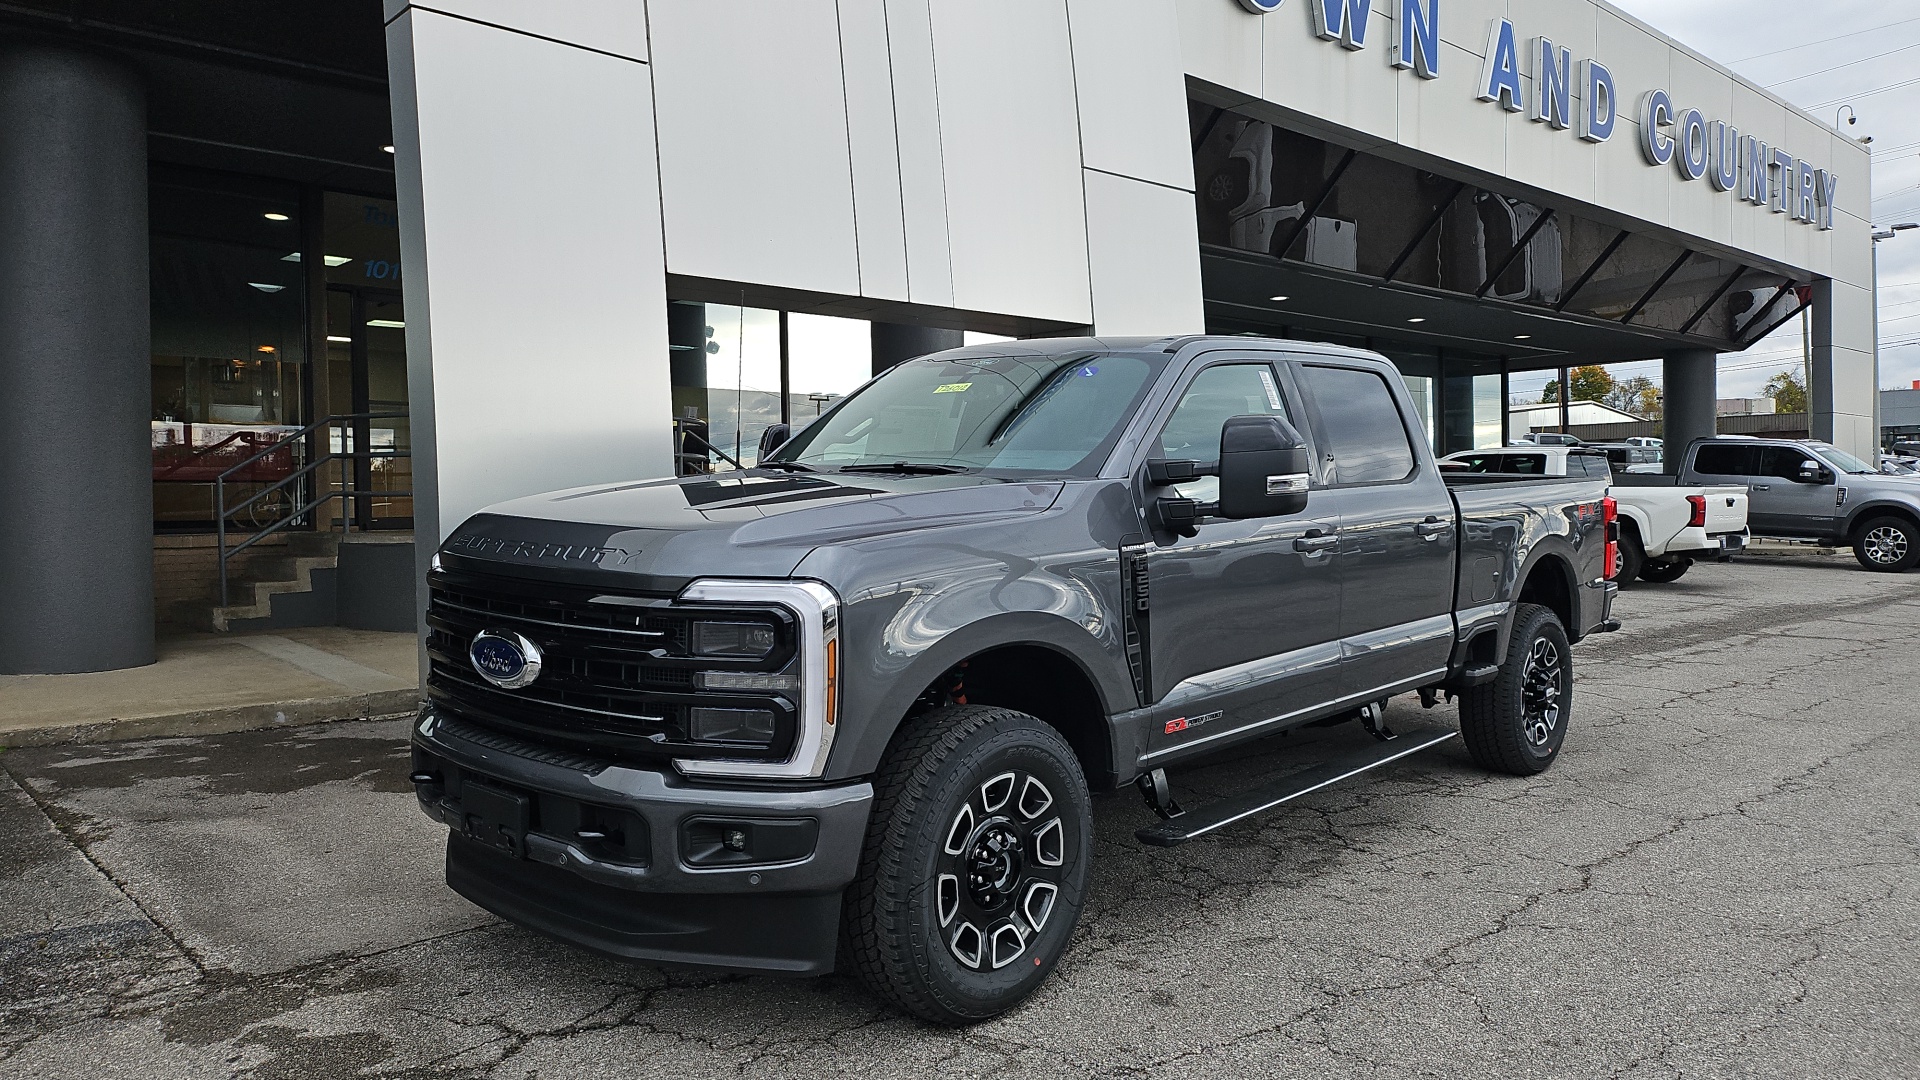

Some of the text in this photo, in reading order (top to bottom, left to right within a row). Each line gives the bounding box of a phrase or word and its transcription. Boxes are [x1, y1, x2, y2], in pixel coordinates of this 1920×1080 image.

[1238, 0, 1838, 230] WN AND COUNTRY
[1579, 503, 1602, 521] FX4
[453, 534, 643, 565] SUPER DUTY
[480, 646, 512, 673] Ford
